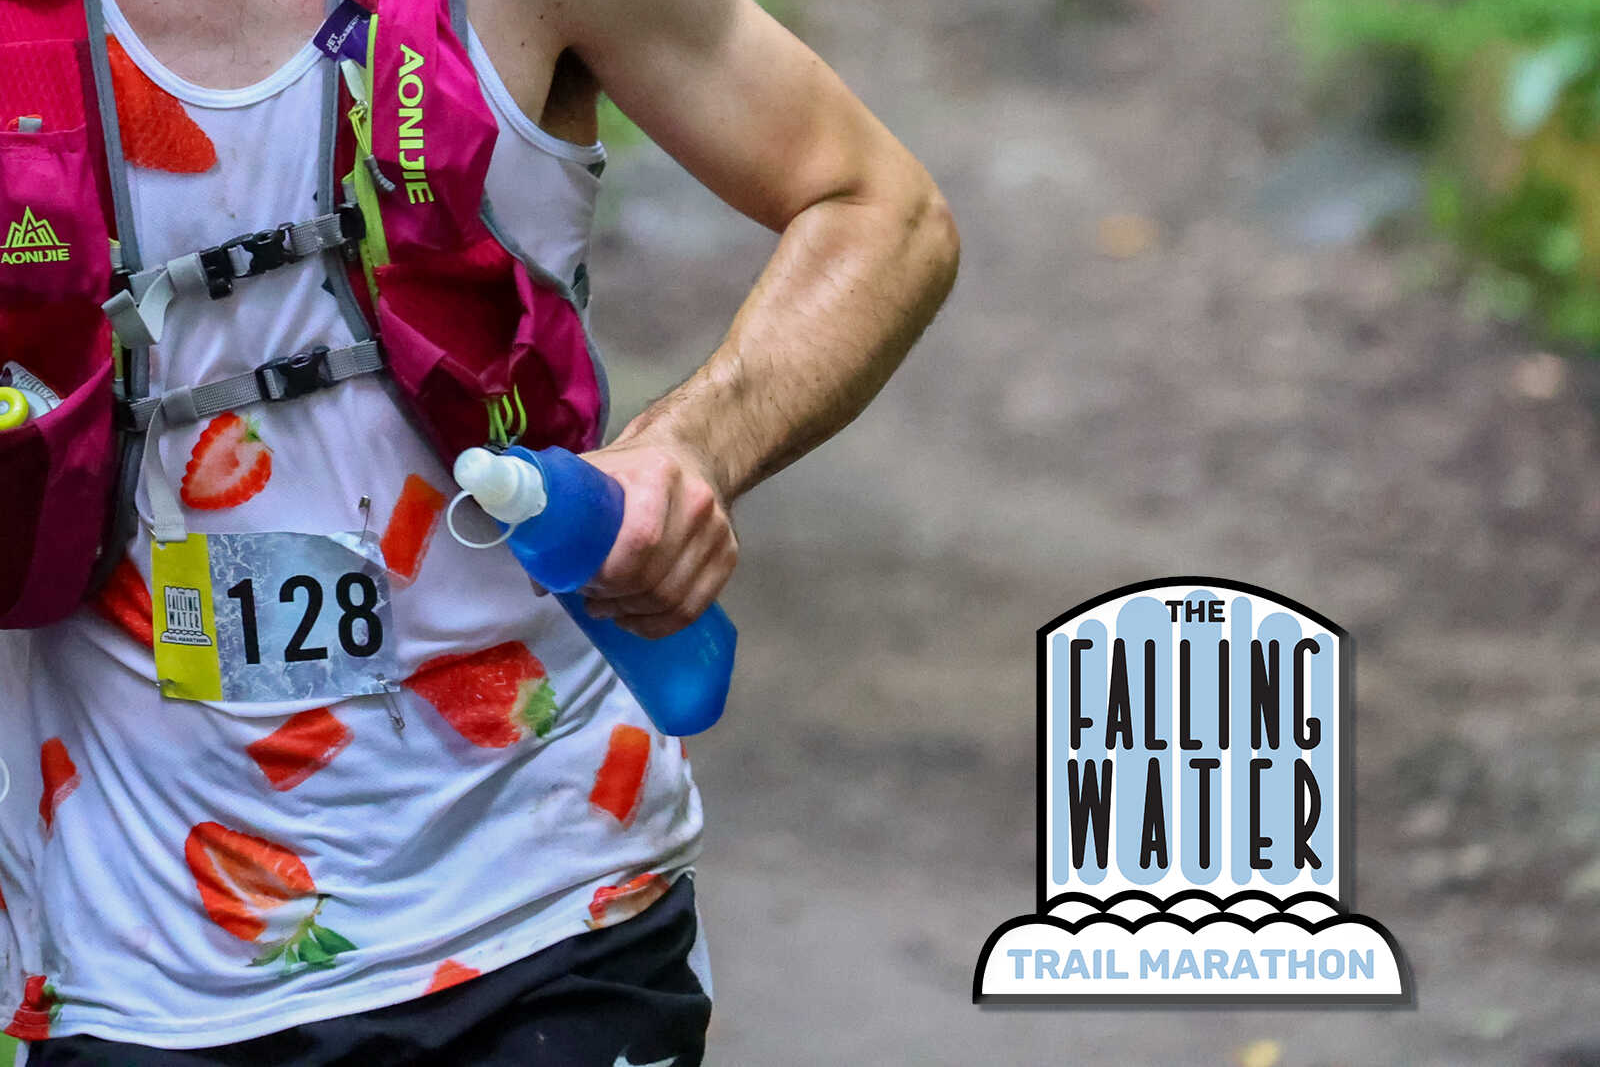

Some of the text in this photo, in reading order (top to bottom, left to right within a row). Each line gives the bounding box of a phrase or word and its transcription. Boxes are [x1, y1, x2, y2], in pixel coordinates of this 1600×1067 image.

[397, 43, 435, 205] AONIJIE
[0, 248, 71, 265] AONIJIE
[167, 594, 199, 612] FALLING
[169, 611, 200, 629] WATER
[227, 572, 383, 665] 128
